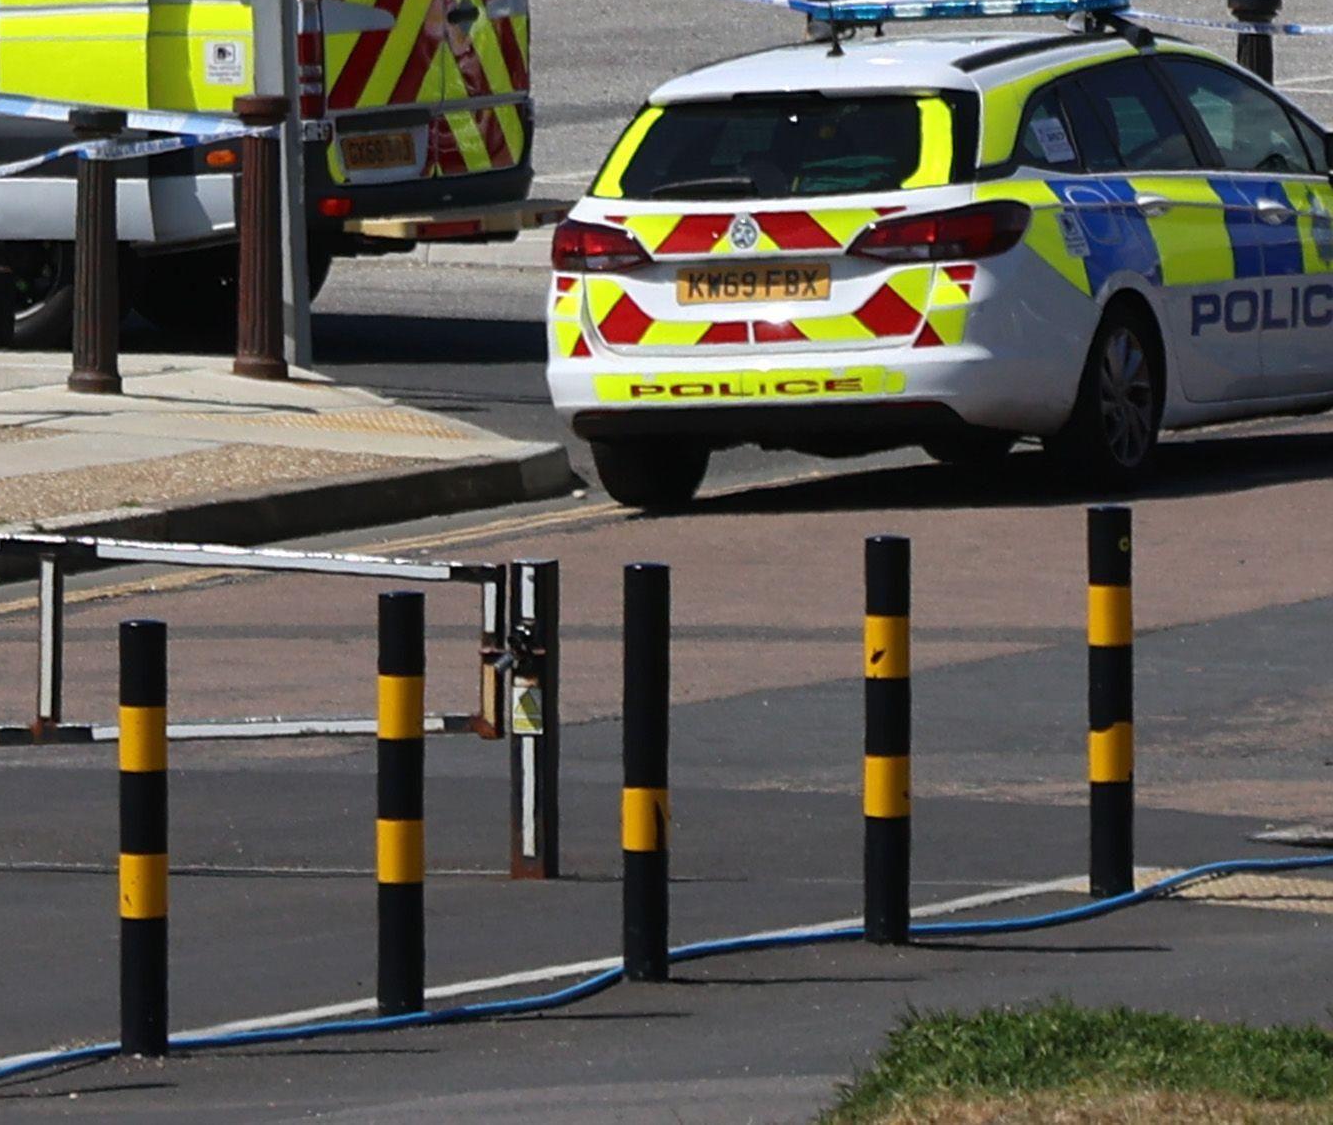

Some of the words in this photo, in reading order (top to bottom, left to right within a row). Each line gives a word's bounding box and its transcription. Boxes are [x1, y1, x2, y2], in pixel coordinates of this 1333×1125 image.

[688, 272, 757, 299] KW69
[765, 269, 820, 297] FBX
[1191, 284, 1333, 336] POLIC
[630, 378, 863, 399] POLICE
